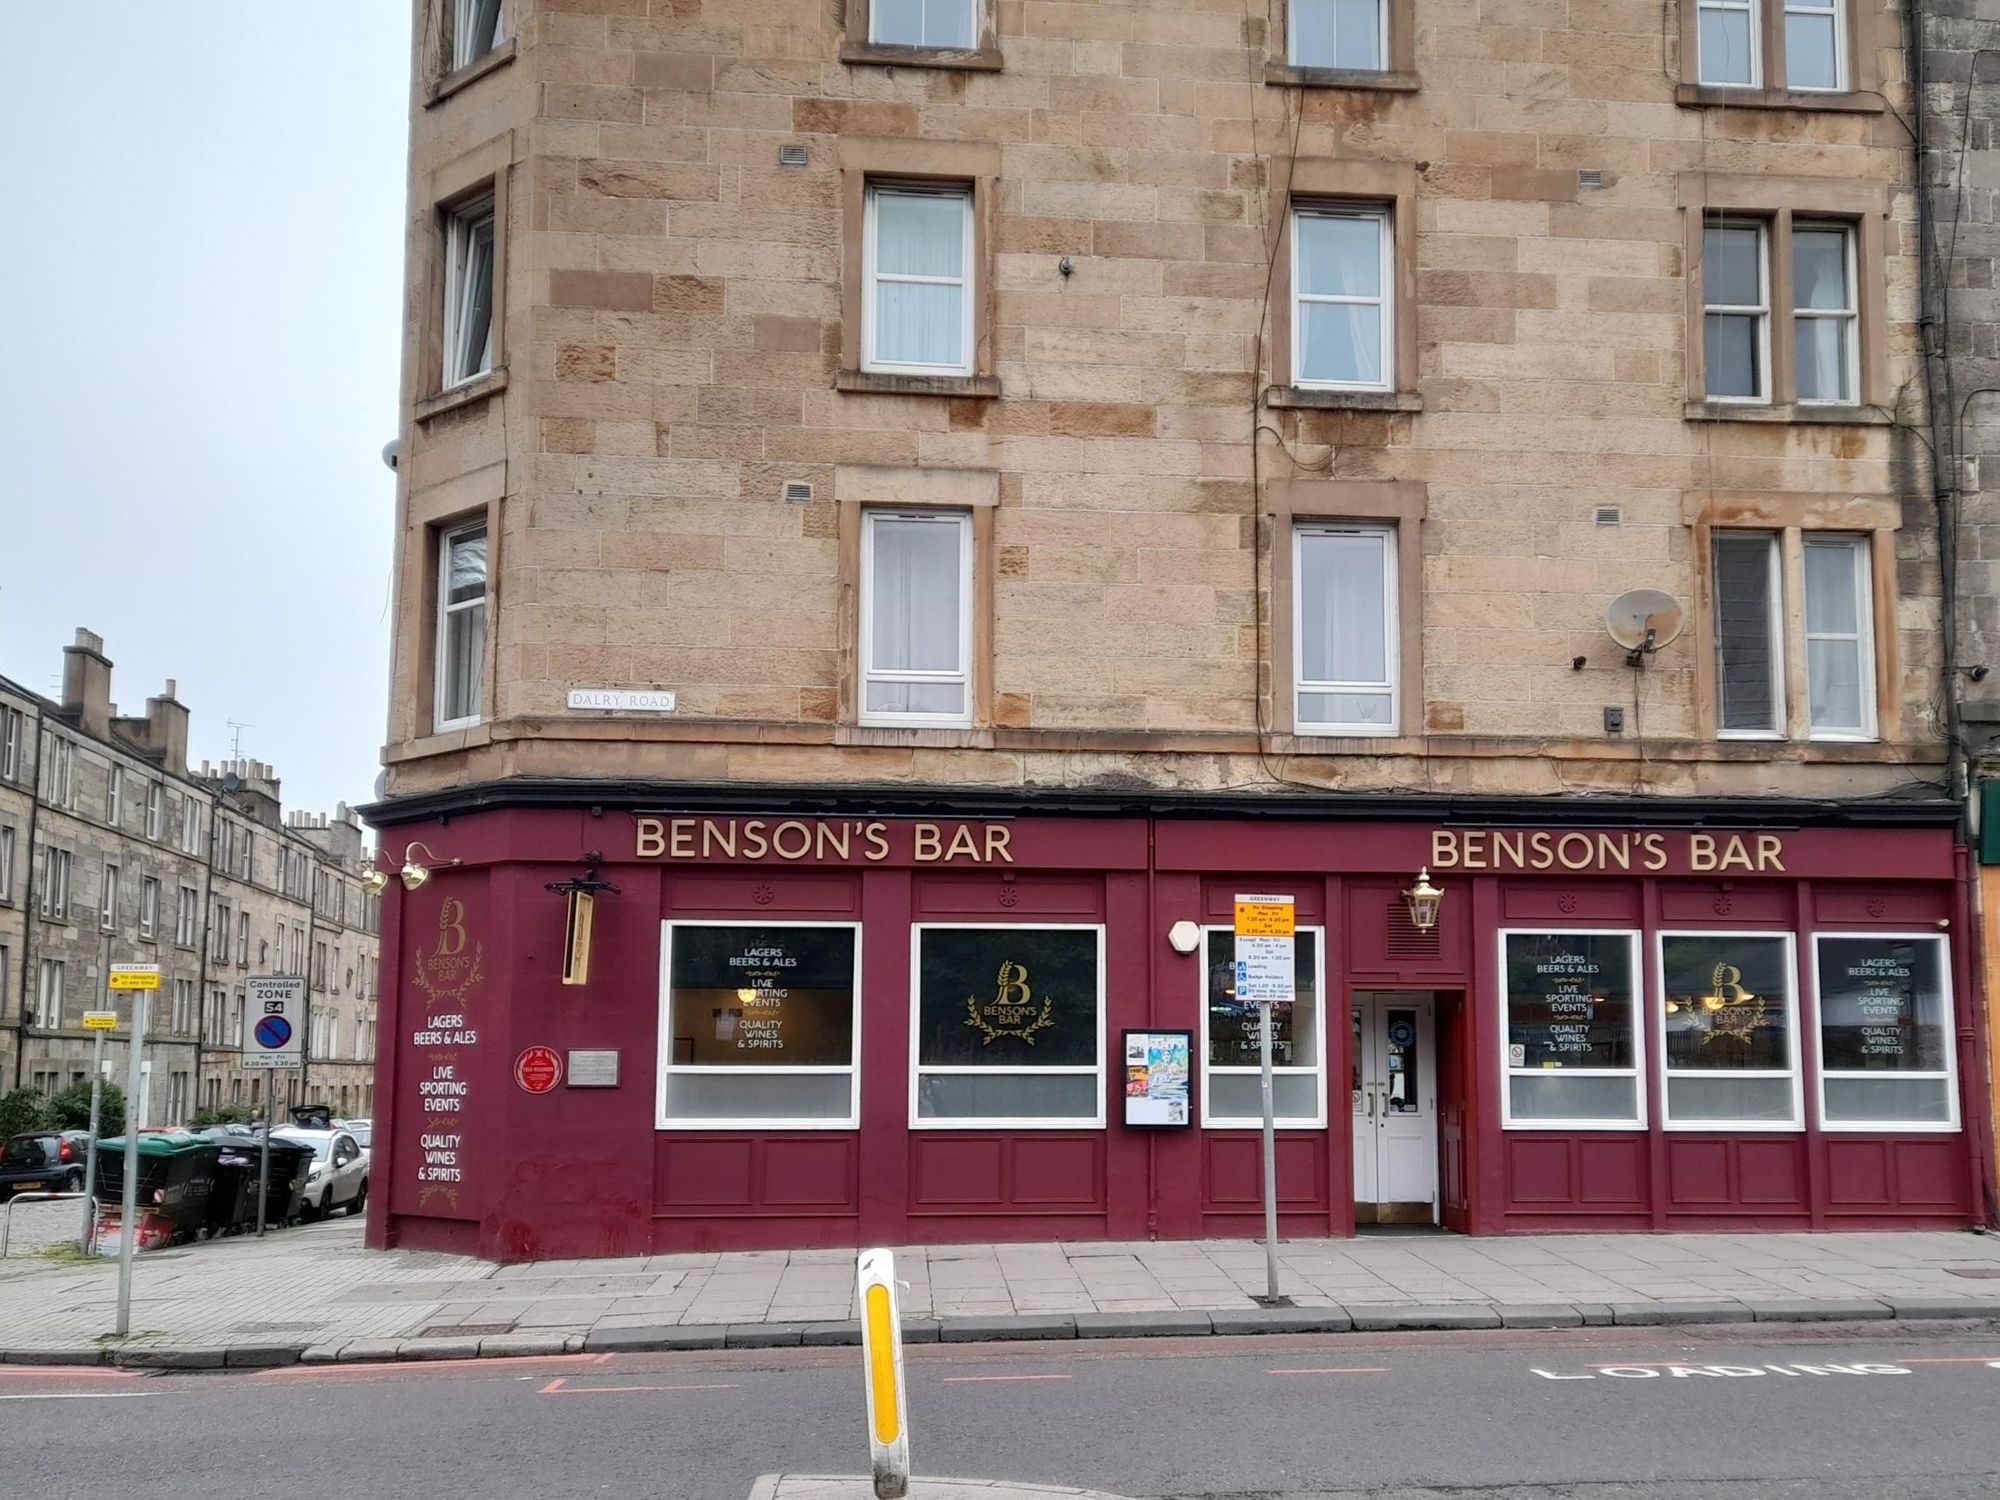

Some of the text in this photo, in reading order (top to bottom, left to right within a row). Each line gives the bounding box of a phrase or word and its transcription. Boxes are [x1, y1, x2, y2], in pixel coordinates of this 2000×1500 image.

[573, 694, 670, 707] DALRY ROAD
[636, 818, 1014, 863] BENSON'S BAR
[1431, 829, 1786, 872] BENSON'S BAR
[744, 948, 783, 957] LAGERS
[729, 957, 797, 967] BEERS & ALES
[1550, 955, 1585, 964] LAGERS
[1861, 958, 1897, 967] LAGERS
[1536, 964, 1599, 973] BEERS & ALES
[1848, 967, 1910, 977] BEERS & ALES
[438, 969, 457, 982] BAR
[249, 980, 300, 989] Controlled
[751, 978, 773, 987] LIVE
[988, 960, 1031, 1005] B
[1559, 985, 1579, 994] LIVE
[1870, 988, 1890, 997] LIVE
[256, 990, 292, 999] ZONE
[1545, 994, 1593, 1003] SPORTING
[1243, 1001, 1280, 1009] EVETS
[1857, 997, 1904, 1006] SPORTING
[265, 1002, 283, 1012] S4
[984, 1006, 1037, 1016] BENSON'S
[1551, 1003, 1587, 1012] EVENTS
[1863, 1006, 1898, 1015] EVENTS
[427, 1014, 463, 1029] LAGERS
[739, 1020, 783, 1029] QUALITY
[998, 1015, 1021, 1025] BAR
[1716, 1015, 1737, 1025] BAR
[1241, 1022, 1283, 1031] QUATY
[1549, 1024, 1590, 1034] QUALITY
[744, 1029, 778, 1039] WINES
[1247, 1031, 1279, 1040] WIS
[1861, 1027, 1902, 1036] QUALITY
[413, 1030, 476, 1045] BEERS & ALES
[1554, 1034, 1586, 1042] WINES
[1866, 1036, 1898, 1045] WINES
[737, 1039, 784, 1049] & SPIRITS
[1241, 1041, 1248, 1050] &
[1549, 1043, 1593, 1052] & SPIRITS
[1861, 1045, 1904, 1054] & SPIRITS
[433, 1066, 453, 1079] LIVE
[419, 1082, 467, 1096] SPORTING
[424, 1098, 460, 1112] EVENTS
[420, 1134, 461, 1150] QUALITY
[425, 1151, 456, 1165] WINES
[418, 1167, 461, 1182] & SPIRITS
[1530, 1363, 1914, 1380] LOADING
